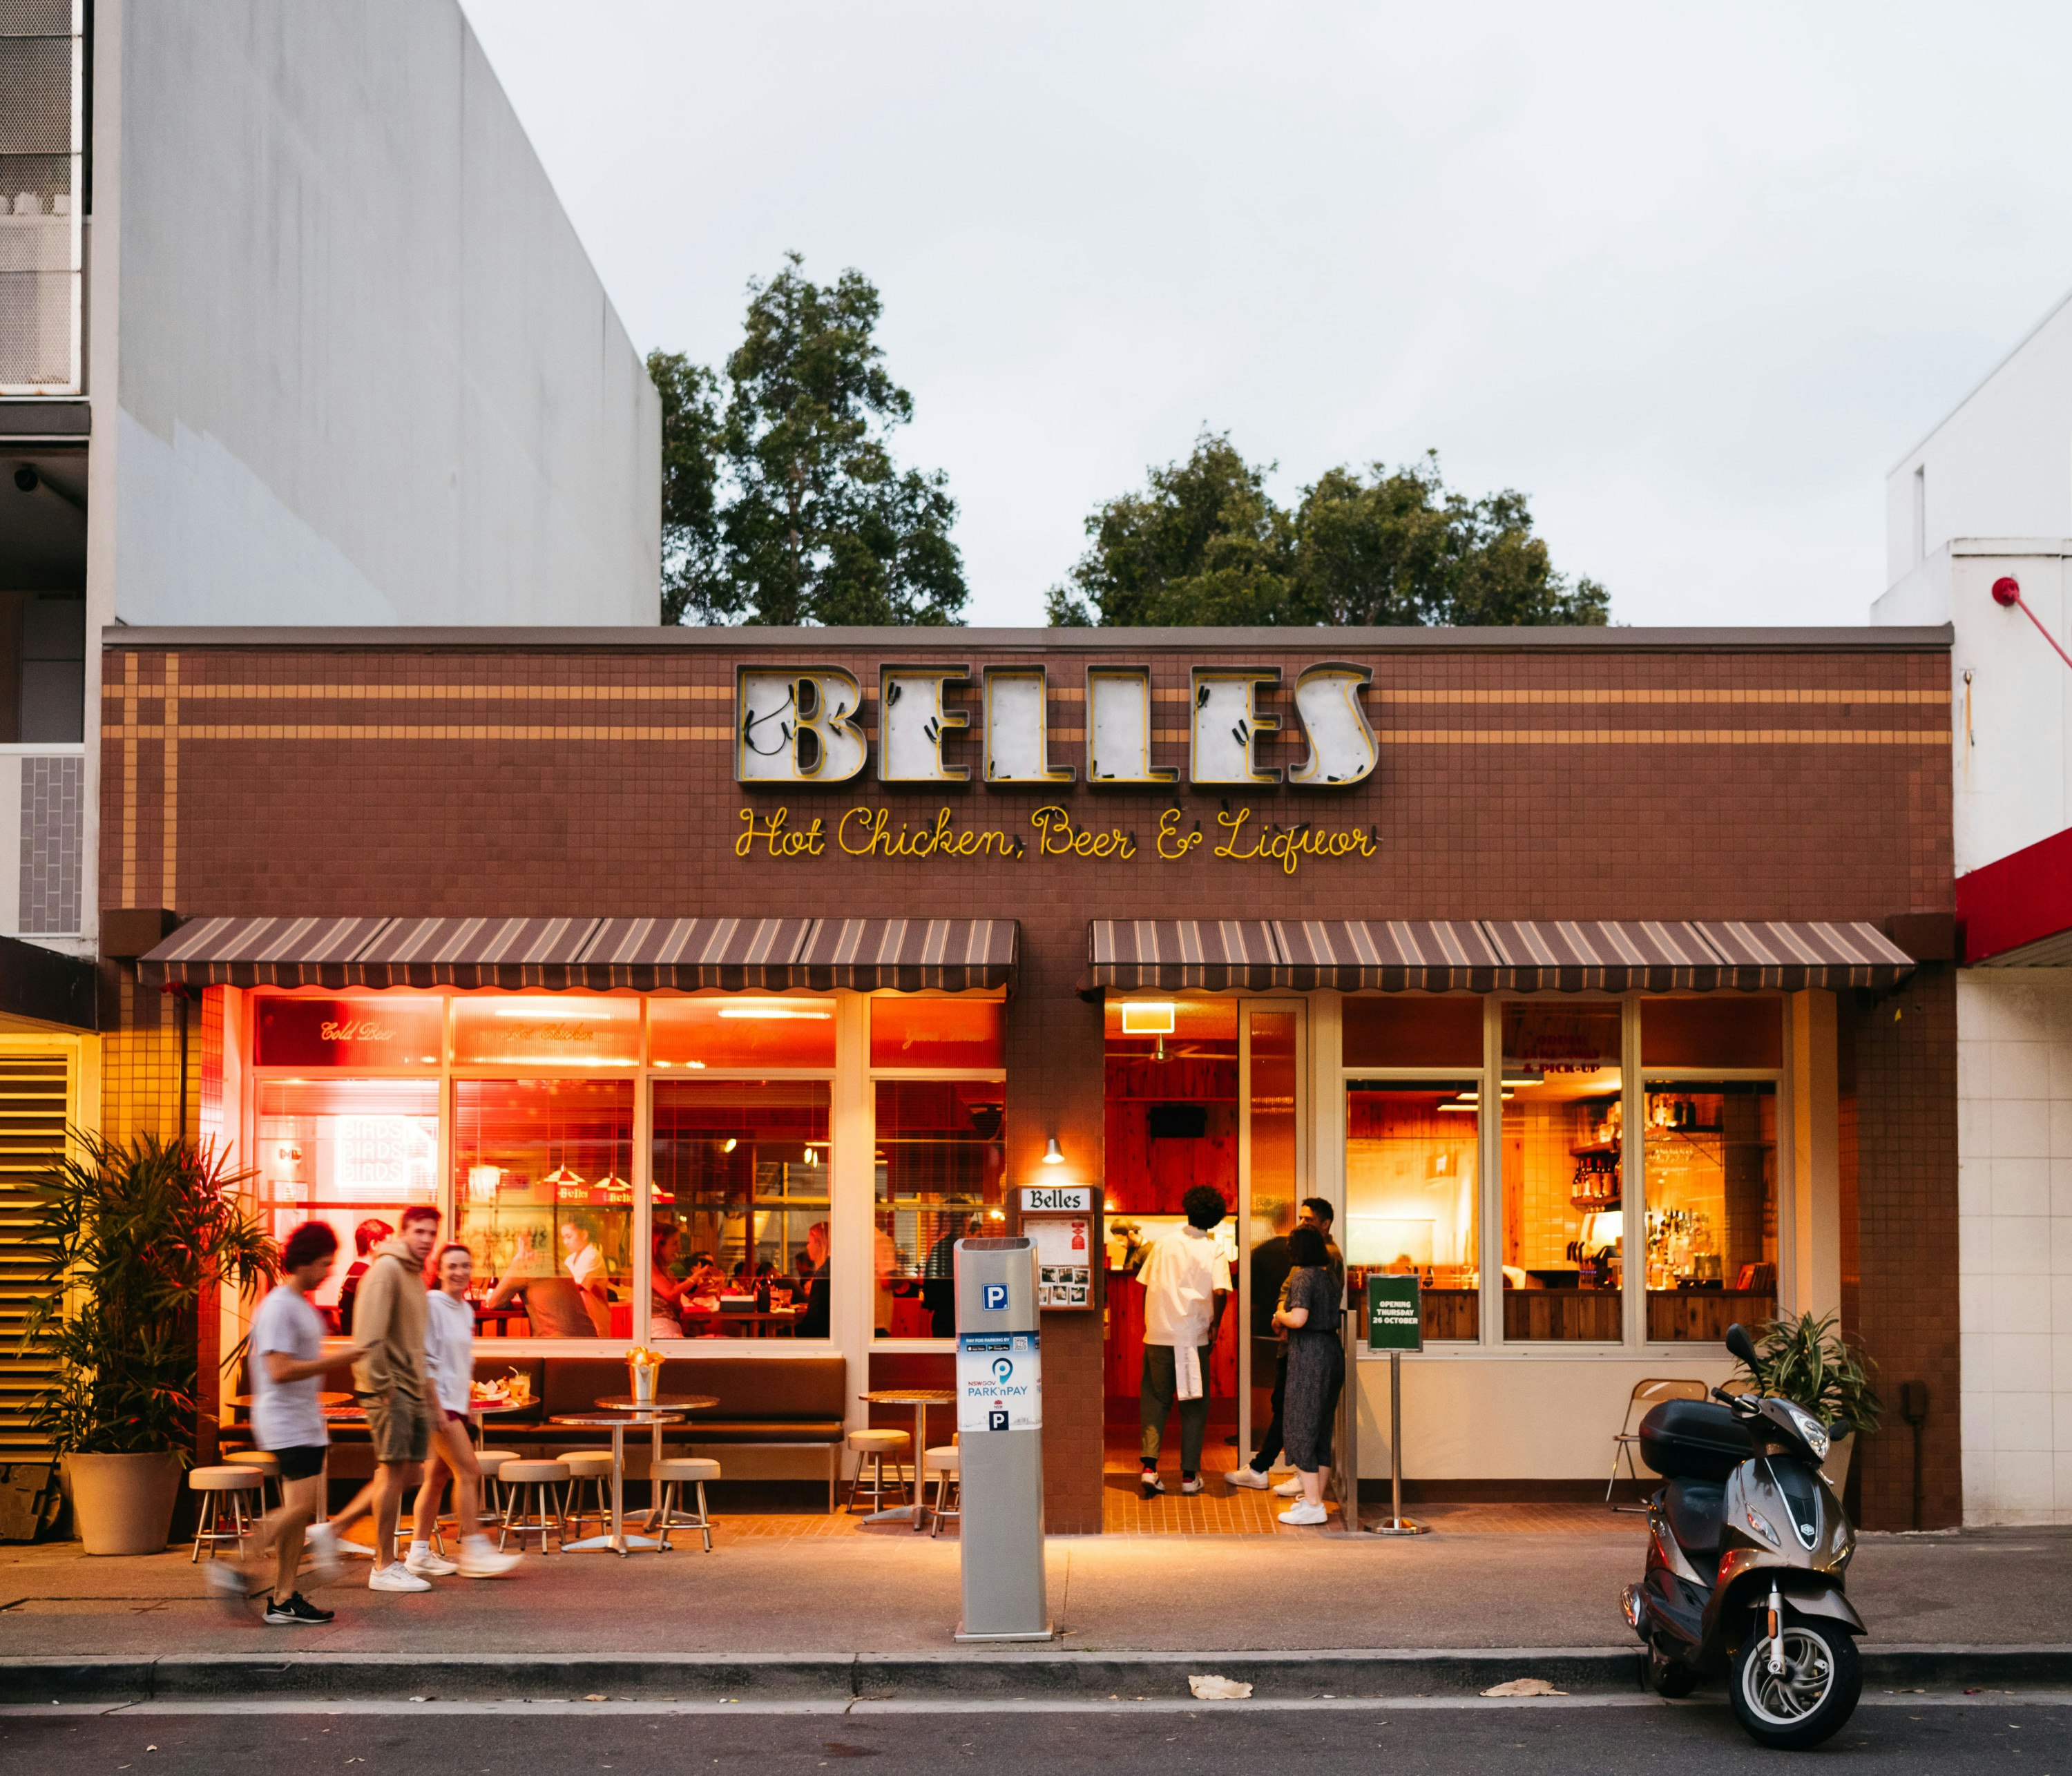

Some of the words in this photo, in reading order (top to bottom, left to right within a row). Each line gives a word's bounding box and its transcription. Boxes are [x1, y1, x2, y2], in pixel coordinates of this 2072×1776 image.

[734, 662, 1379, 786] BELLES
[736, 807, 825, 856] Hot
[838, 807, 1022, 859] Chicken,
[1031, 806, 1136, 859] Beer
[1157, 808, 1202, 858] &
[1214, 807, 1377, 874] Liquor
[321, 1021, 360, 1041] Cold
[1539, 1063, 1600, 1073] PICK-UP
[345, 1121, 403, 1139] BIRDS
[345, 1141, 403, 1159] BIRDS
[345, 1162, 402, 1181] BIRDS
[1030, 1190, 1081, 1208] Belles
[988, 1286, 1004, 1309] P
[993, 1413, 1004, 1429] P
